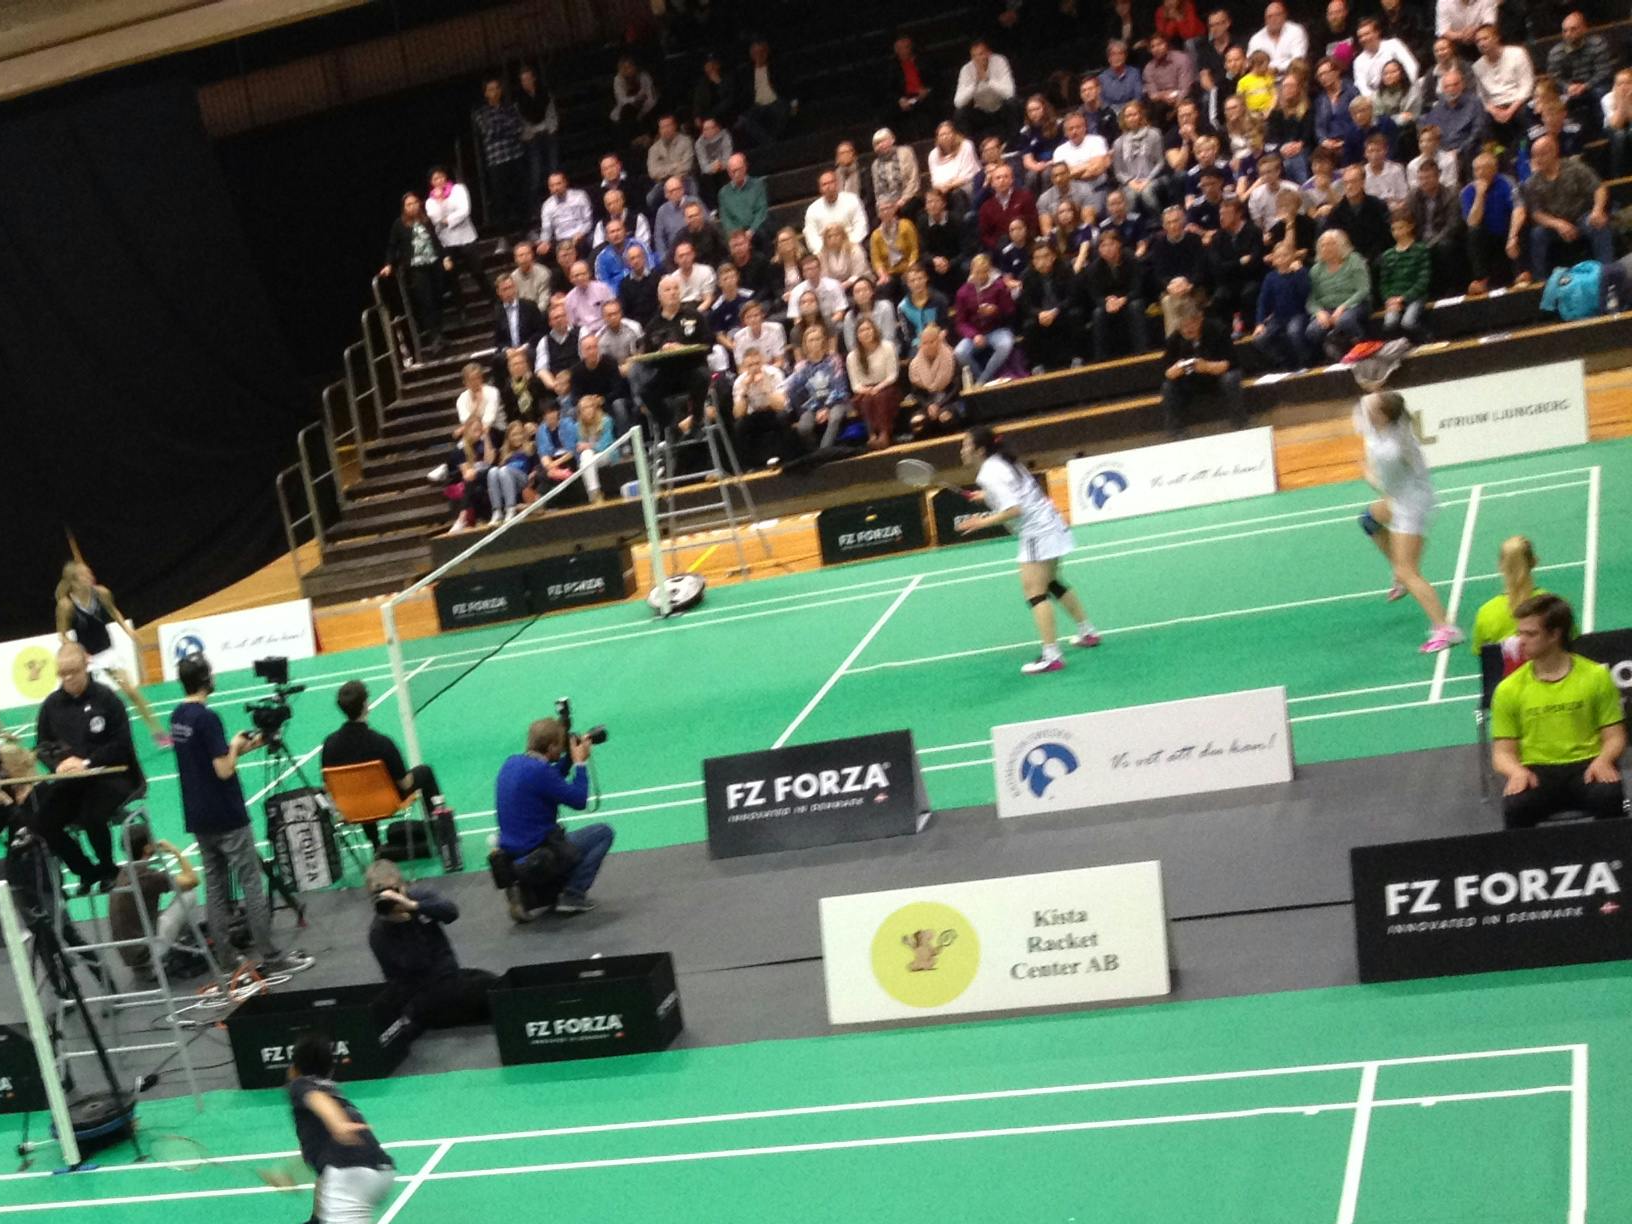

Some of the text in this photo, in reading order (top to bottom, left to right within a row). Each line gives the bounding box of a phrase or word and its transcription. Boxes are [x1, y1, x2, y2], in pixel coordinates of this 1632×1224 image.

[726, 763, 890, 809] FZ FORZA
[1384, 861, 1621, 917] FZ FORZA
[1033, 908, 1088, 927] Kista
[1387, 906, 1584, 935] INNOVATED IN DENMARK
[1027, 932, 1099, 953] Racket
[1009, 954, 1120, 980] Center AB
[525, 1014, 623, 1037] FZ FORZA
[261, 1046, 285, 1063] FZ
